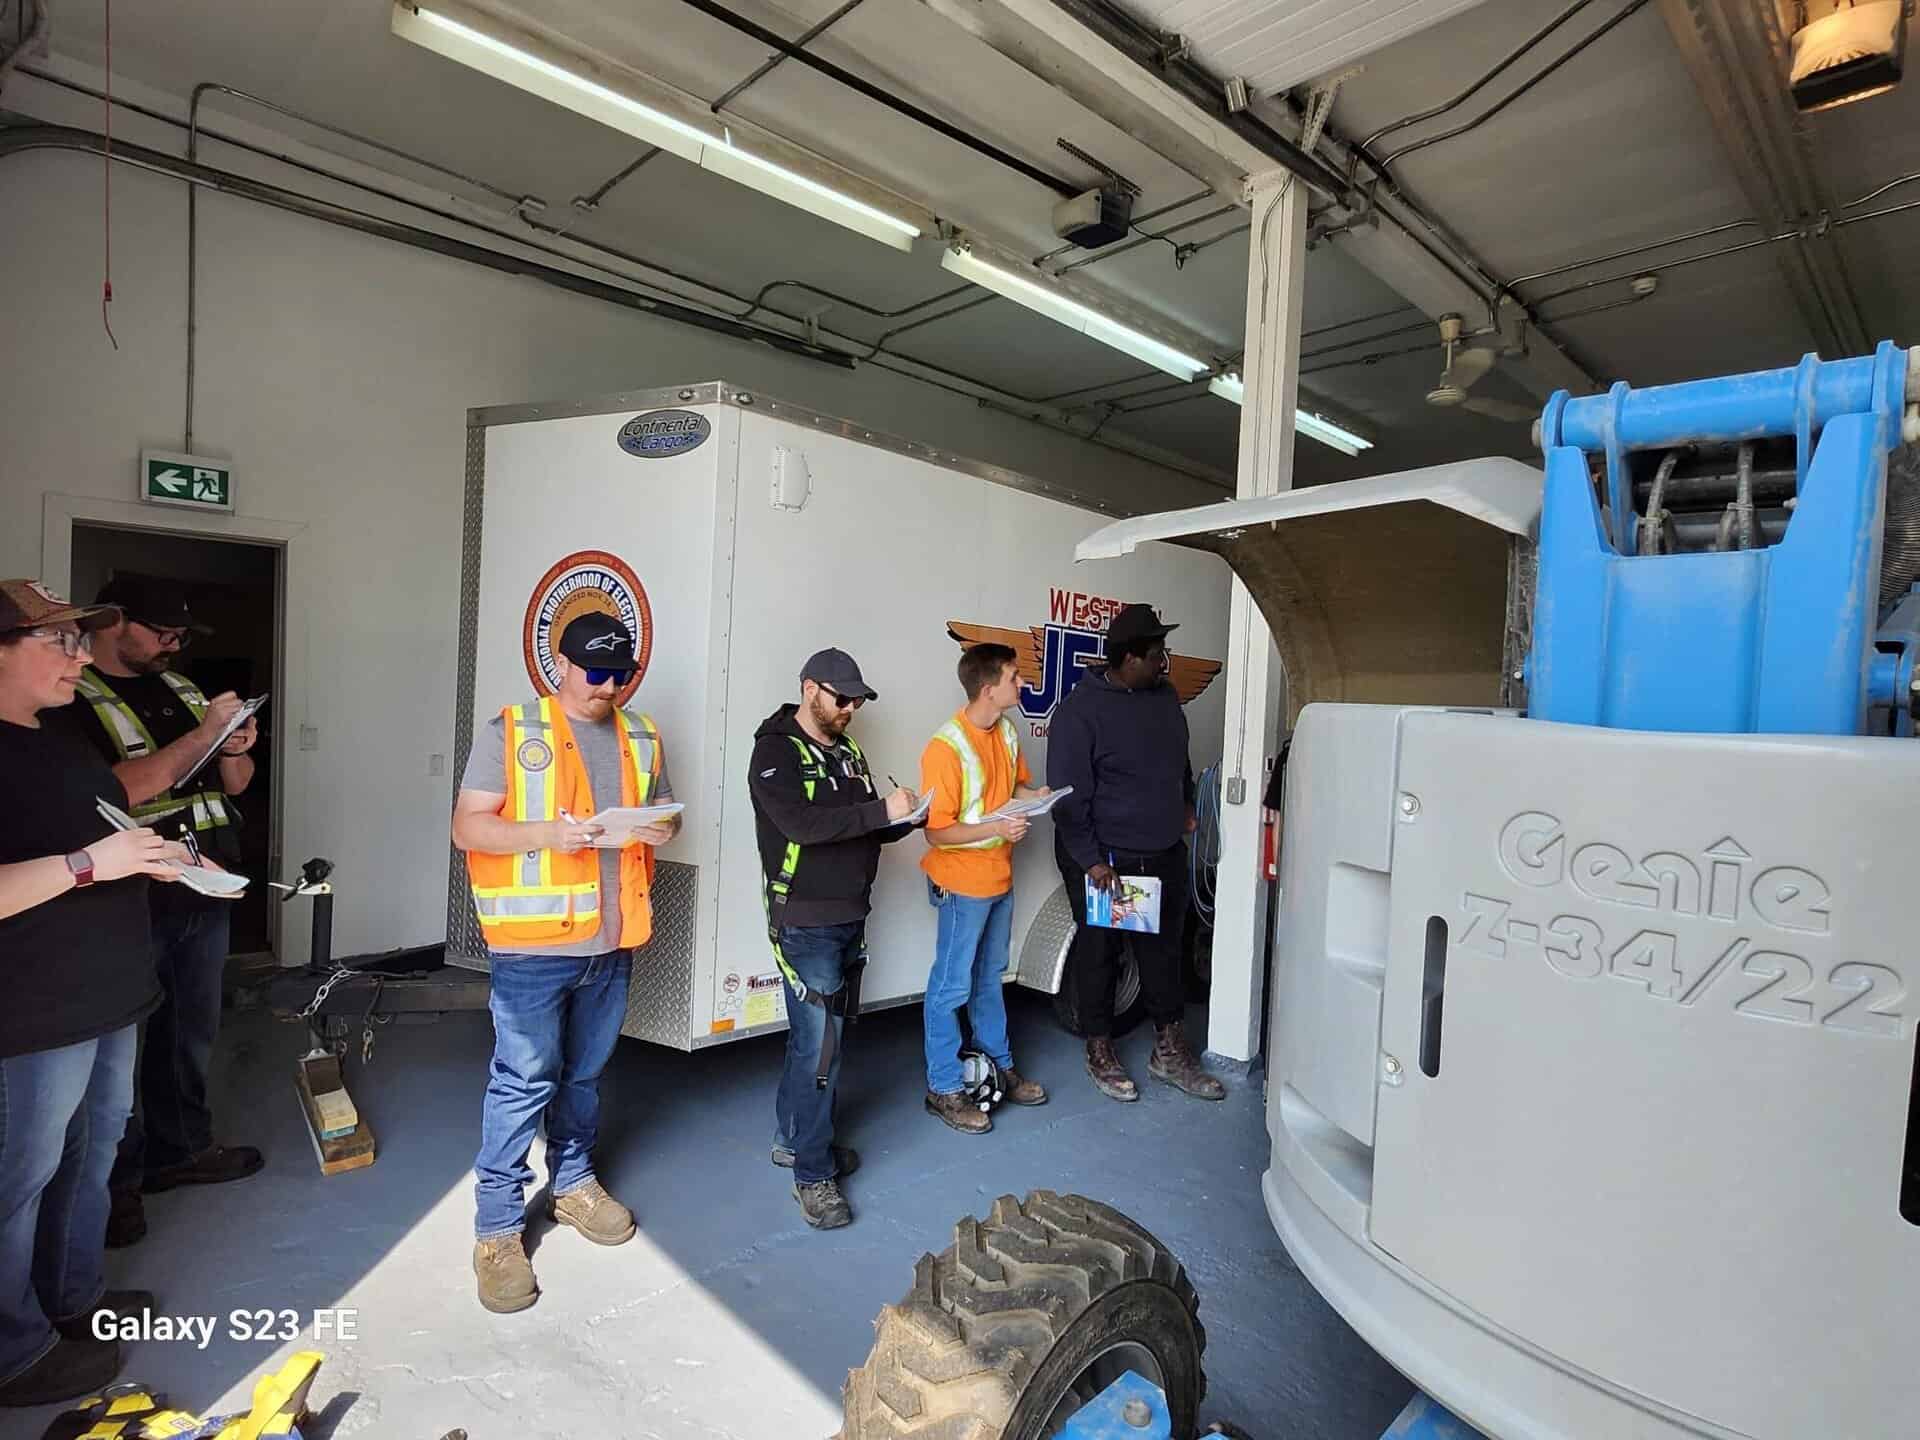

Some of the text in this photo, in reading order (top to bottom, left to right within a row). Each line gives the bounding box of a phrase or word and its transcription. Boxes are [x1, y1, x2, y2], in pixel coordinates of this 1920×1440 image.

[623, 415, 704, 436] Continental
[641, 433, 684, 452] Cargo
[541, 573, 601, 622] BROTHERHOOD
[601, 576, 616, 593] OF
[1051, 587, 1132, 631] WEST
[538, 623, 562, 689] RNATIONAL
[1030, 722, 1051, 738] Tak
[1497, 809, 1833, 937] Genie
[1453, 890, 1906, 1040] Z-34/22
